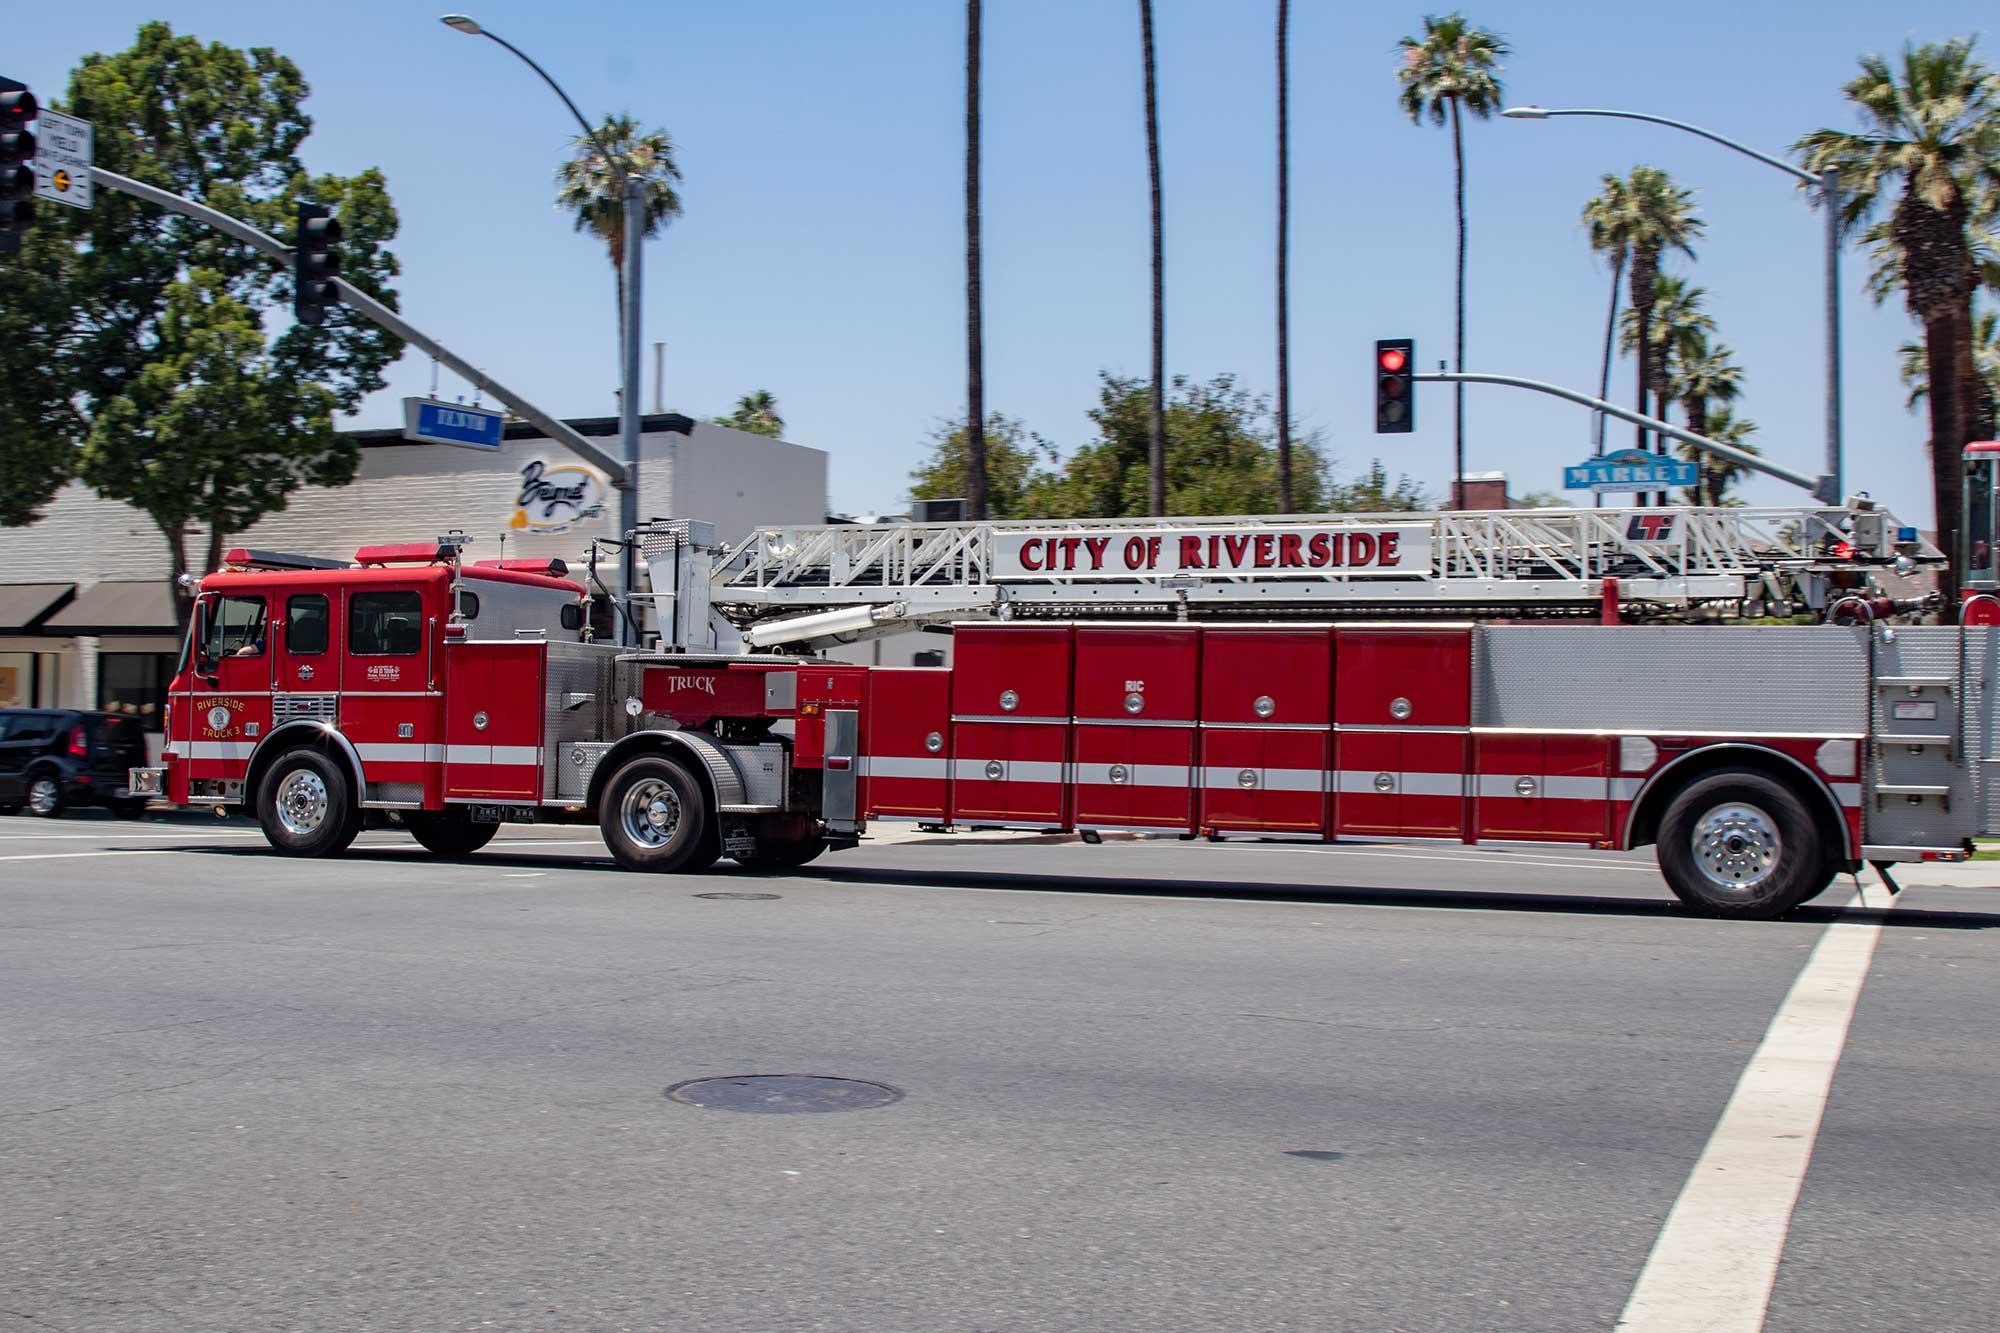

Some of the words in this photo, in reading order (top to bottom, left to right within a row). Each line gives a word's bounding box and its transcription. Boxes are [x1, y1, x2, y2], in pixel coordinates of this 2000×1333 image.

[1569, 465, 1690, 483] MARKET
[1019, 536, 1112, 571] CITY
[1123, 535, 1163, 570] OF
[1177, 531, 1401, 570] RIVERSIDE
[668, 675, 716, 696] TRUCK
[1124, 680, 1145, 692] RIC
[196, 697, 245, 712] RIVERSIDE
[202, 726, 233, 739] TRUCK
[233, 726, 241, 735] 3
